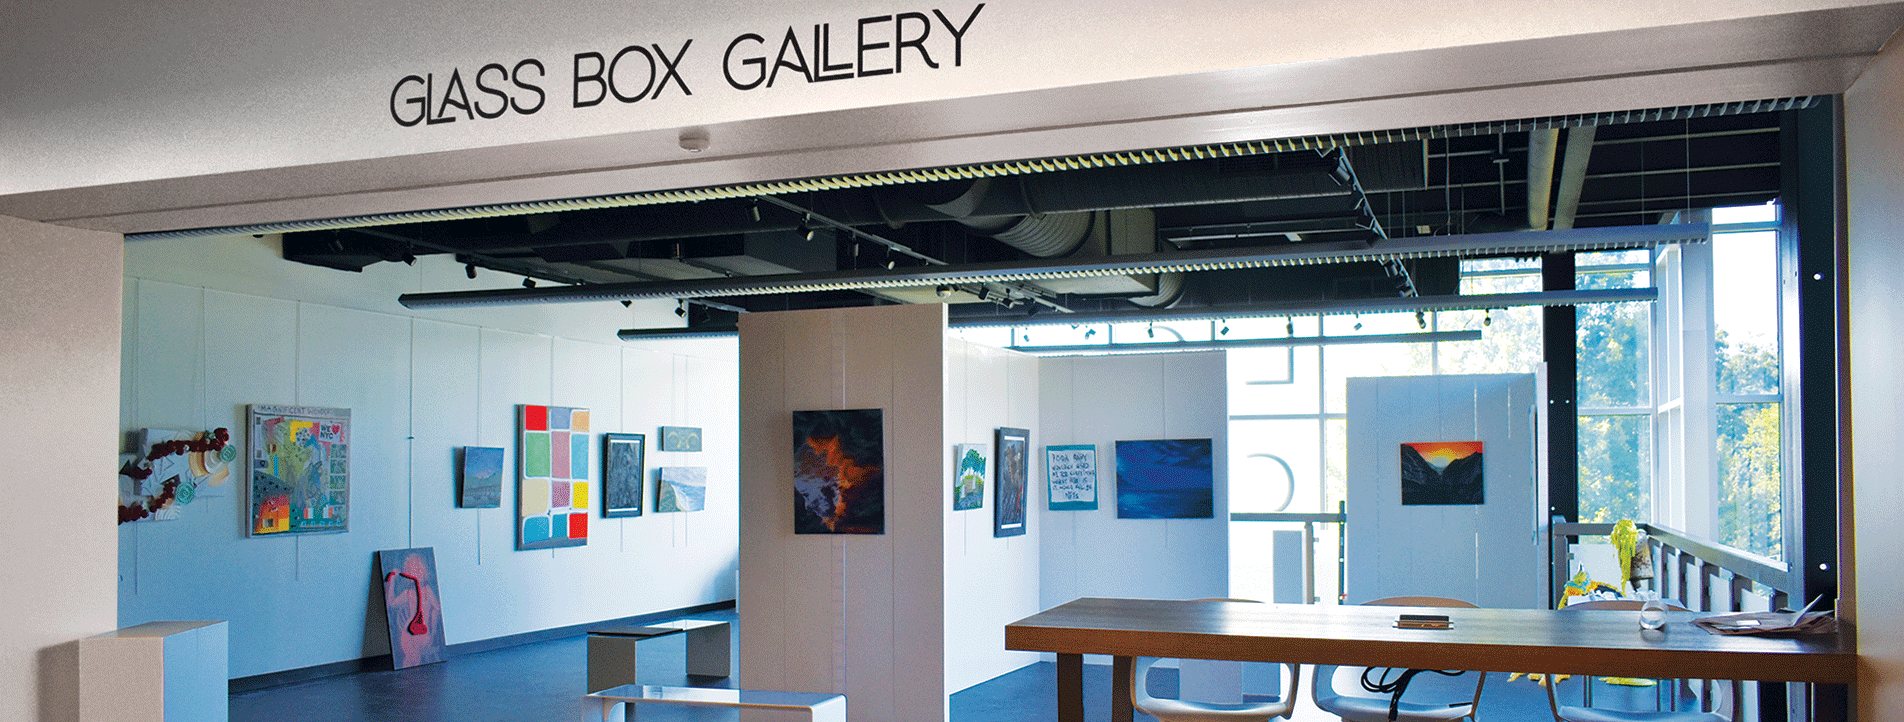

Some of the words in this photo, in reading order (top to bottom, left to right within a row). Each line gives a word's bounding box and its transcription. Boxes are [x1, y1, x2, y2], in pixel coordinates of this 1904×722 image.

[390, 59, 545, 128] GLASS
[573, 39, 693, 109] BOX
[723, 3, 986, 92] GALLERY
[320, 424, 331, 433] WE
[320, 432, 333, 440] NYC
